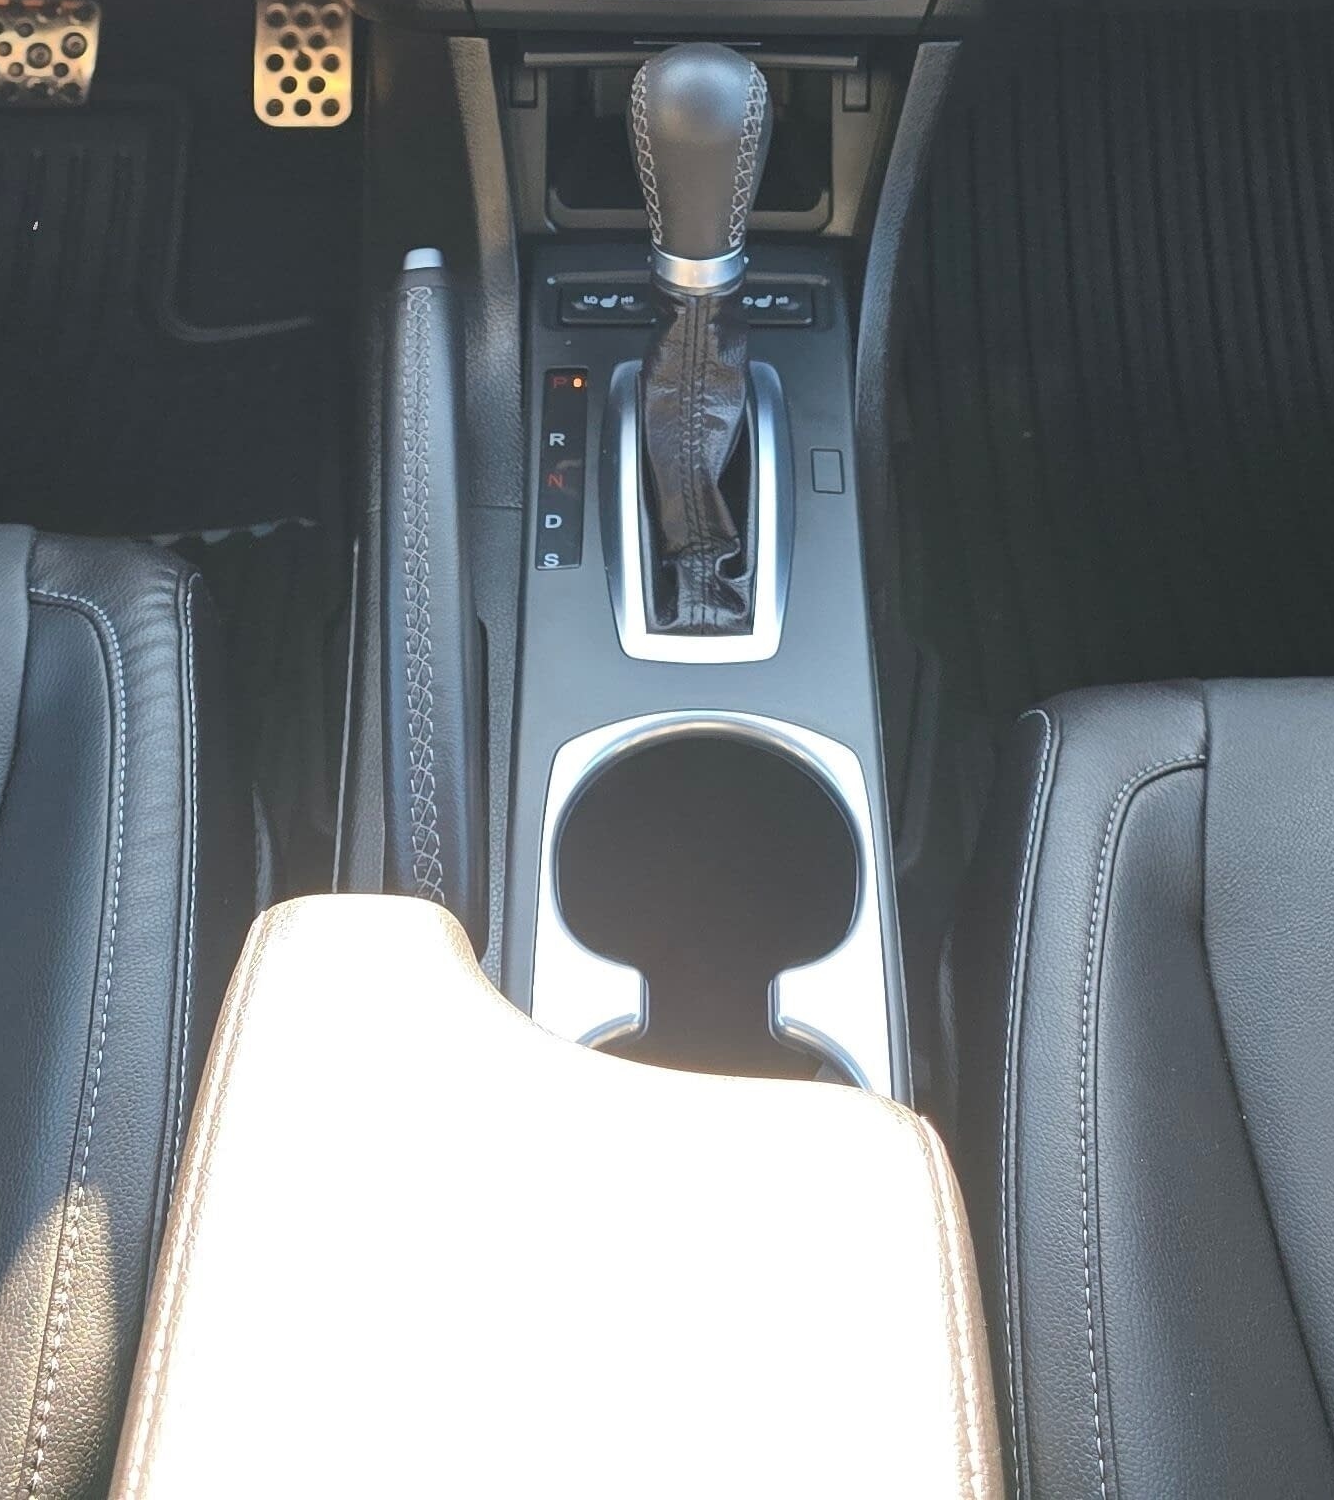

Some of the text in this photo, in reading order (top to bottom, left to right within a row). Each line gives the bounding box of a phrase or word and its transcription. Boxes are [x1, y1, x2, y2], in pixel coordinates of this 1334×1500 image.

[553, 377, 567, 388] P
[549, 433, 565, 446] R
[547, 473, 563, 488] N
[544, 514, 563, 529] D
[543, 553, 560, 568] S
